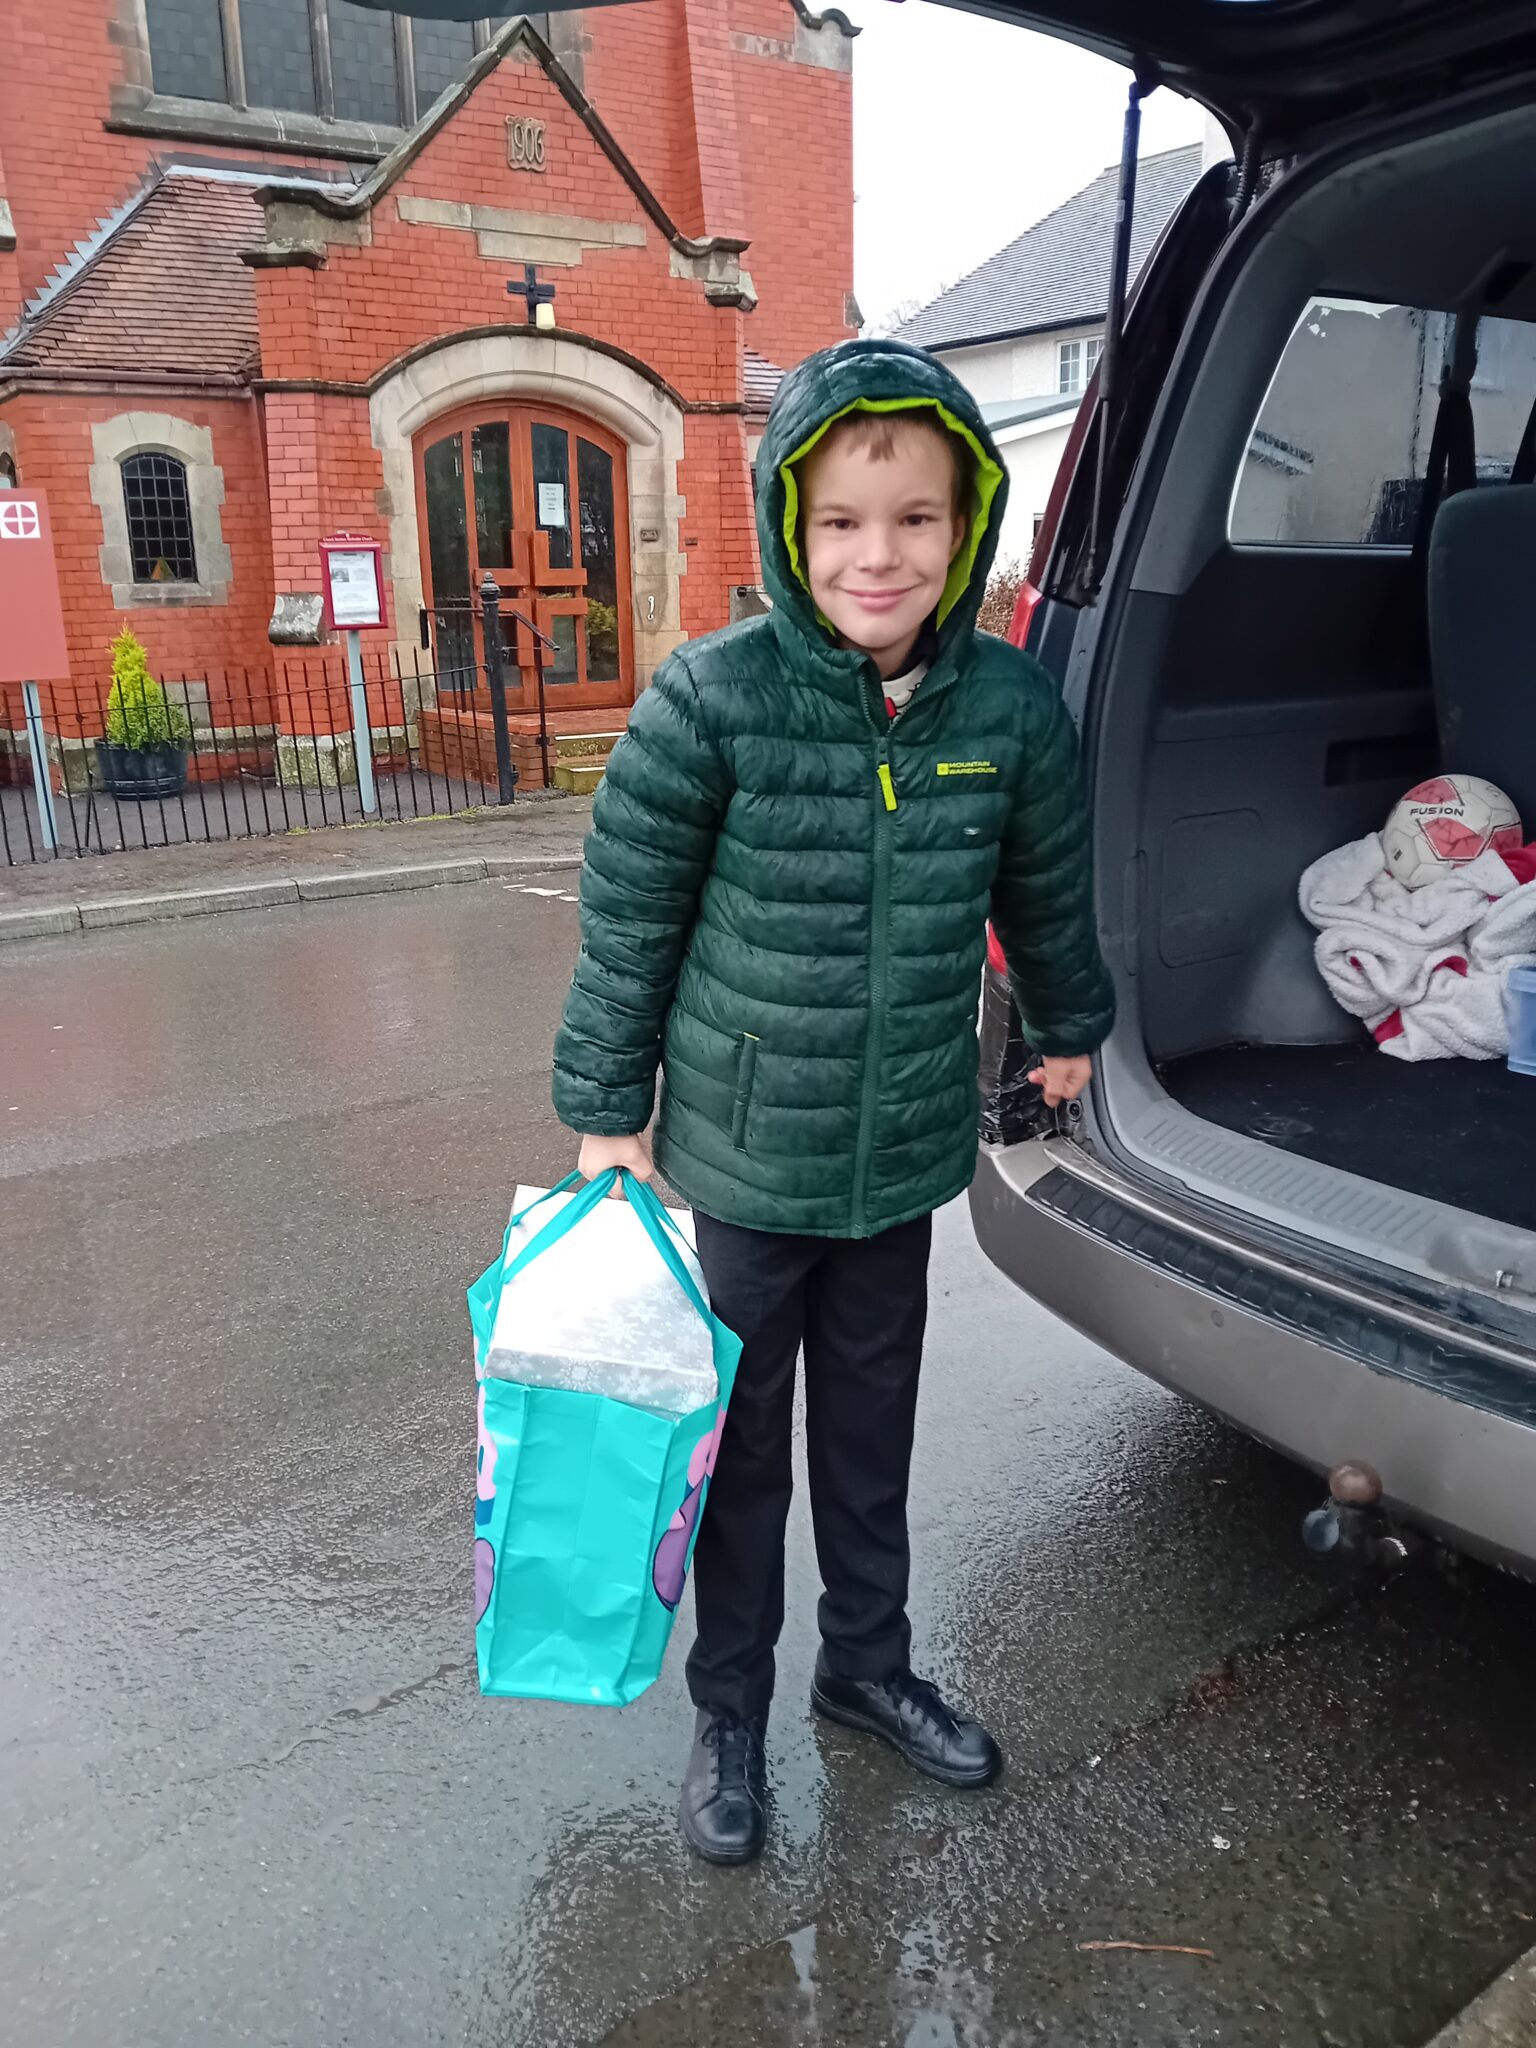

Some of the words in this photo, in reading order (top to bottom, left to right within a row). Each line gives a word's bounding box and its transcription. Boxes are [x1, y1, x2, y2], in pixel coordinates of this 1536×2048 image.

[507, 119, 545, 163] 1906
[949, 760, 991, 768] MOUNTAIN
[1410, 807, 1464, 817] FUSION
